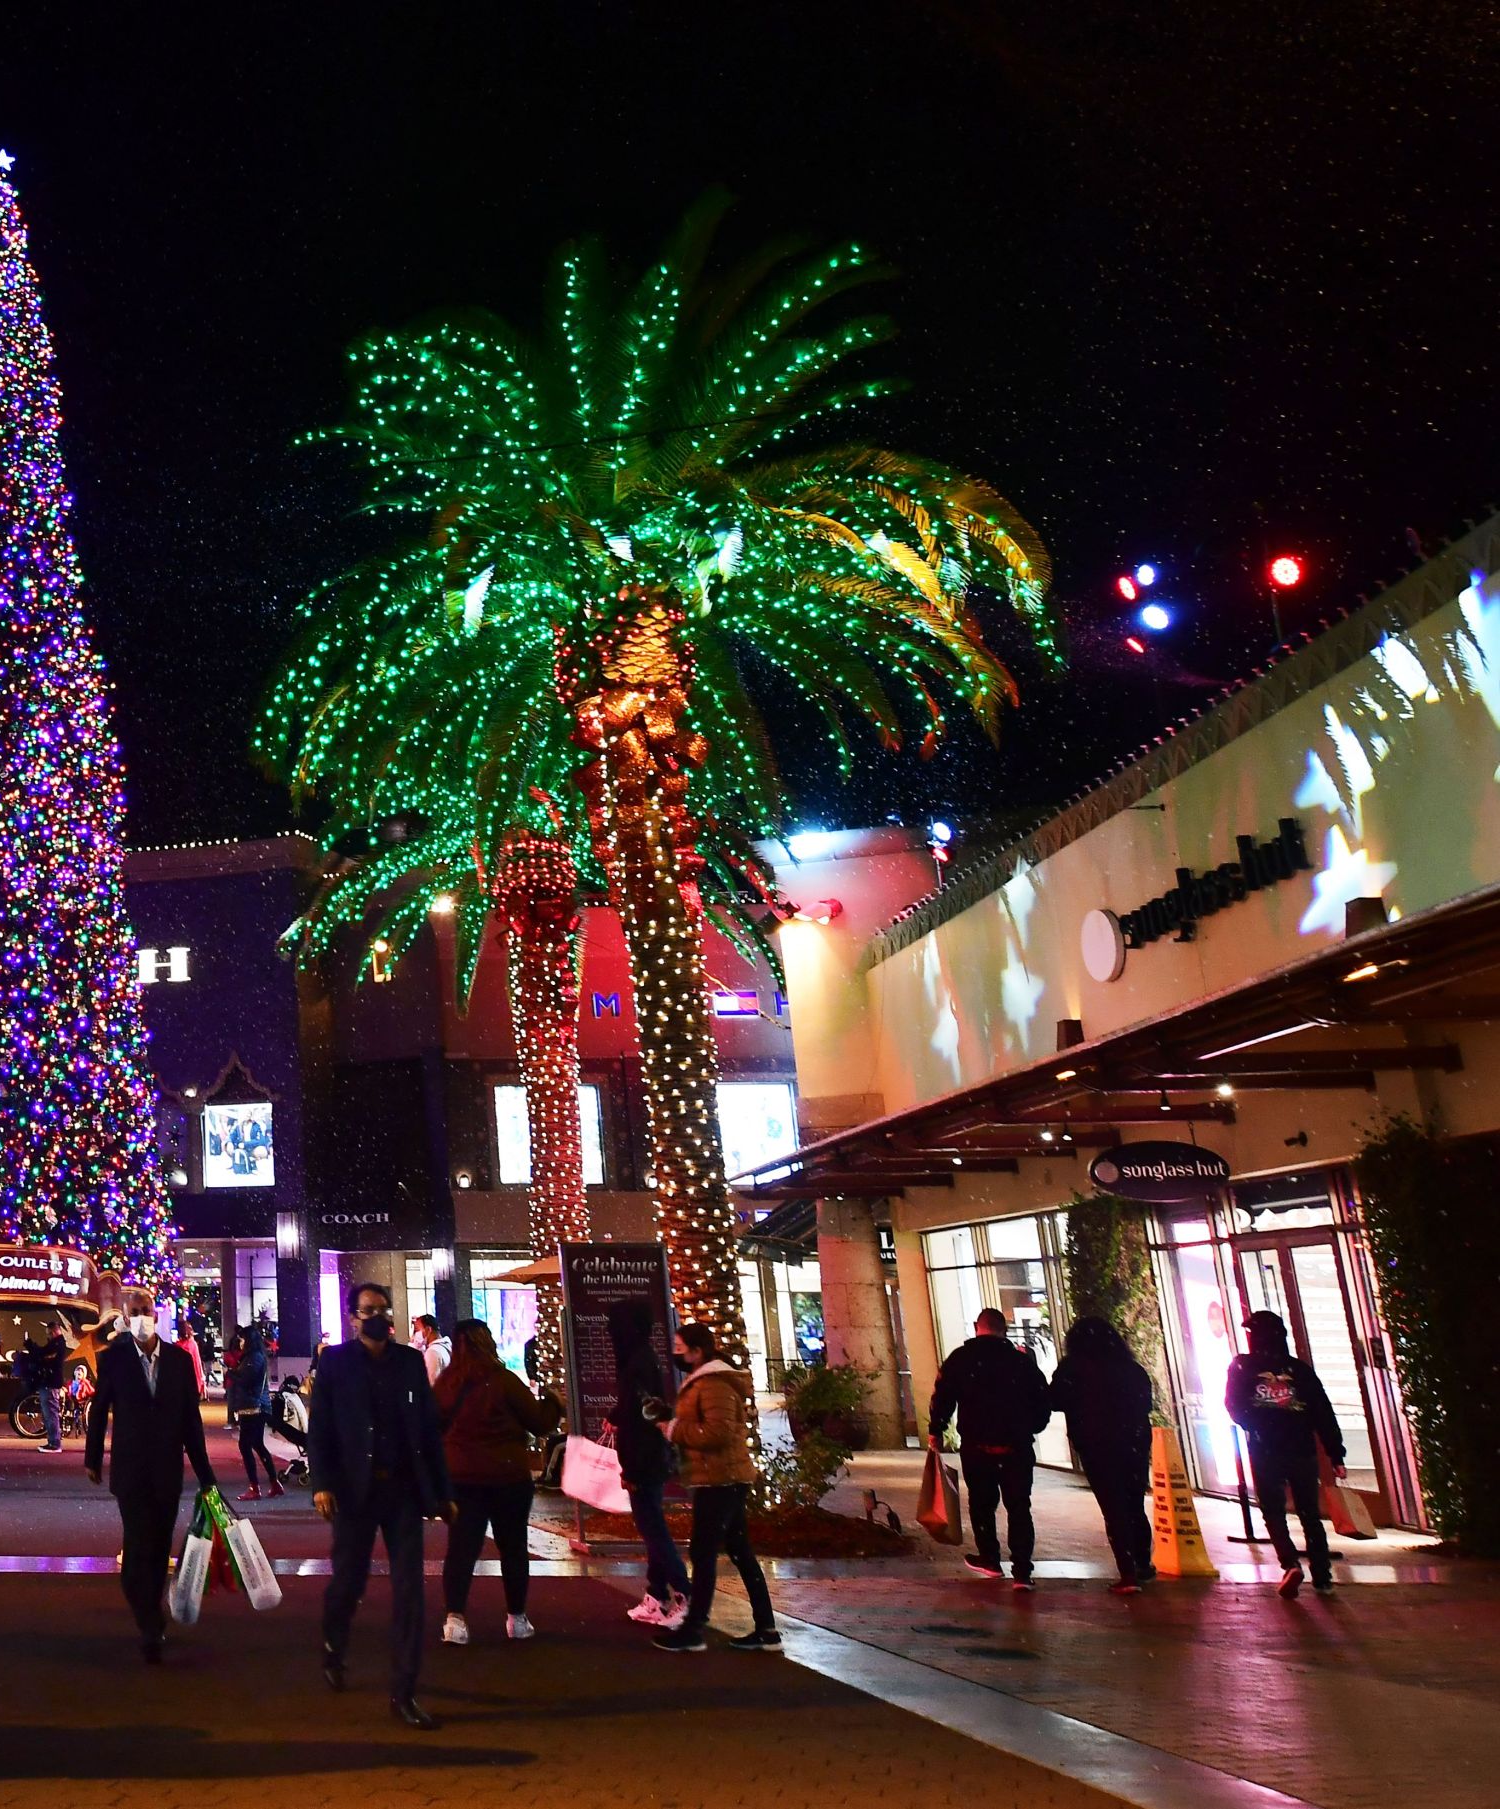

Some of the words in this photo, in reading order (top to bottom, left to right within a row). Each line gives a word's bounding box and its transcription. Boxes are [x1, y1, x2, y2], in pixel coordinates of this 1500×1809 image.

[1235, 818, 1313, 891] hut
[1122, 1161, 1195, 1182] sunglass
[1196, 1160, 1226, 1177] hut
[321, 1212, 389, 1224] COACH
[0, 1255, 64, 1271] OUTLETS
[572, 1256, 658, 1273] Celebrate
[47, 1277, 80, 1295] Tree
[583, 1274, 600, 1285] the
[576, 1313, 610, 1322] Novemb
[583, 1393, 619, 1403] Decembe
